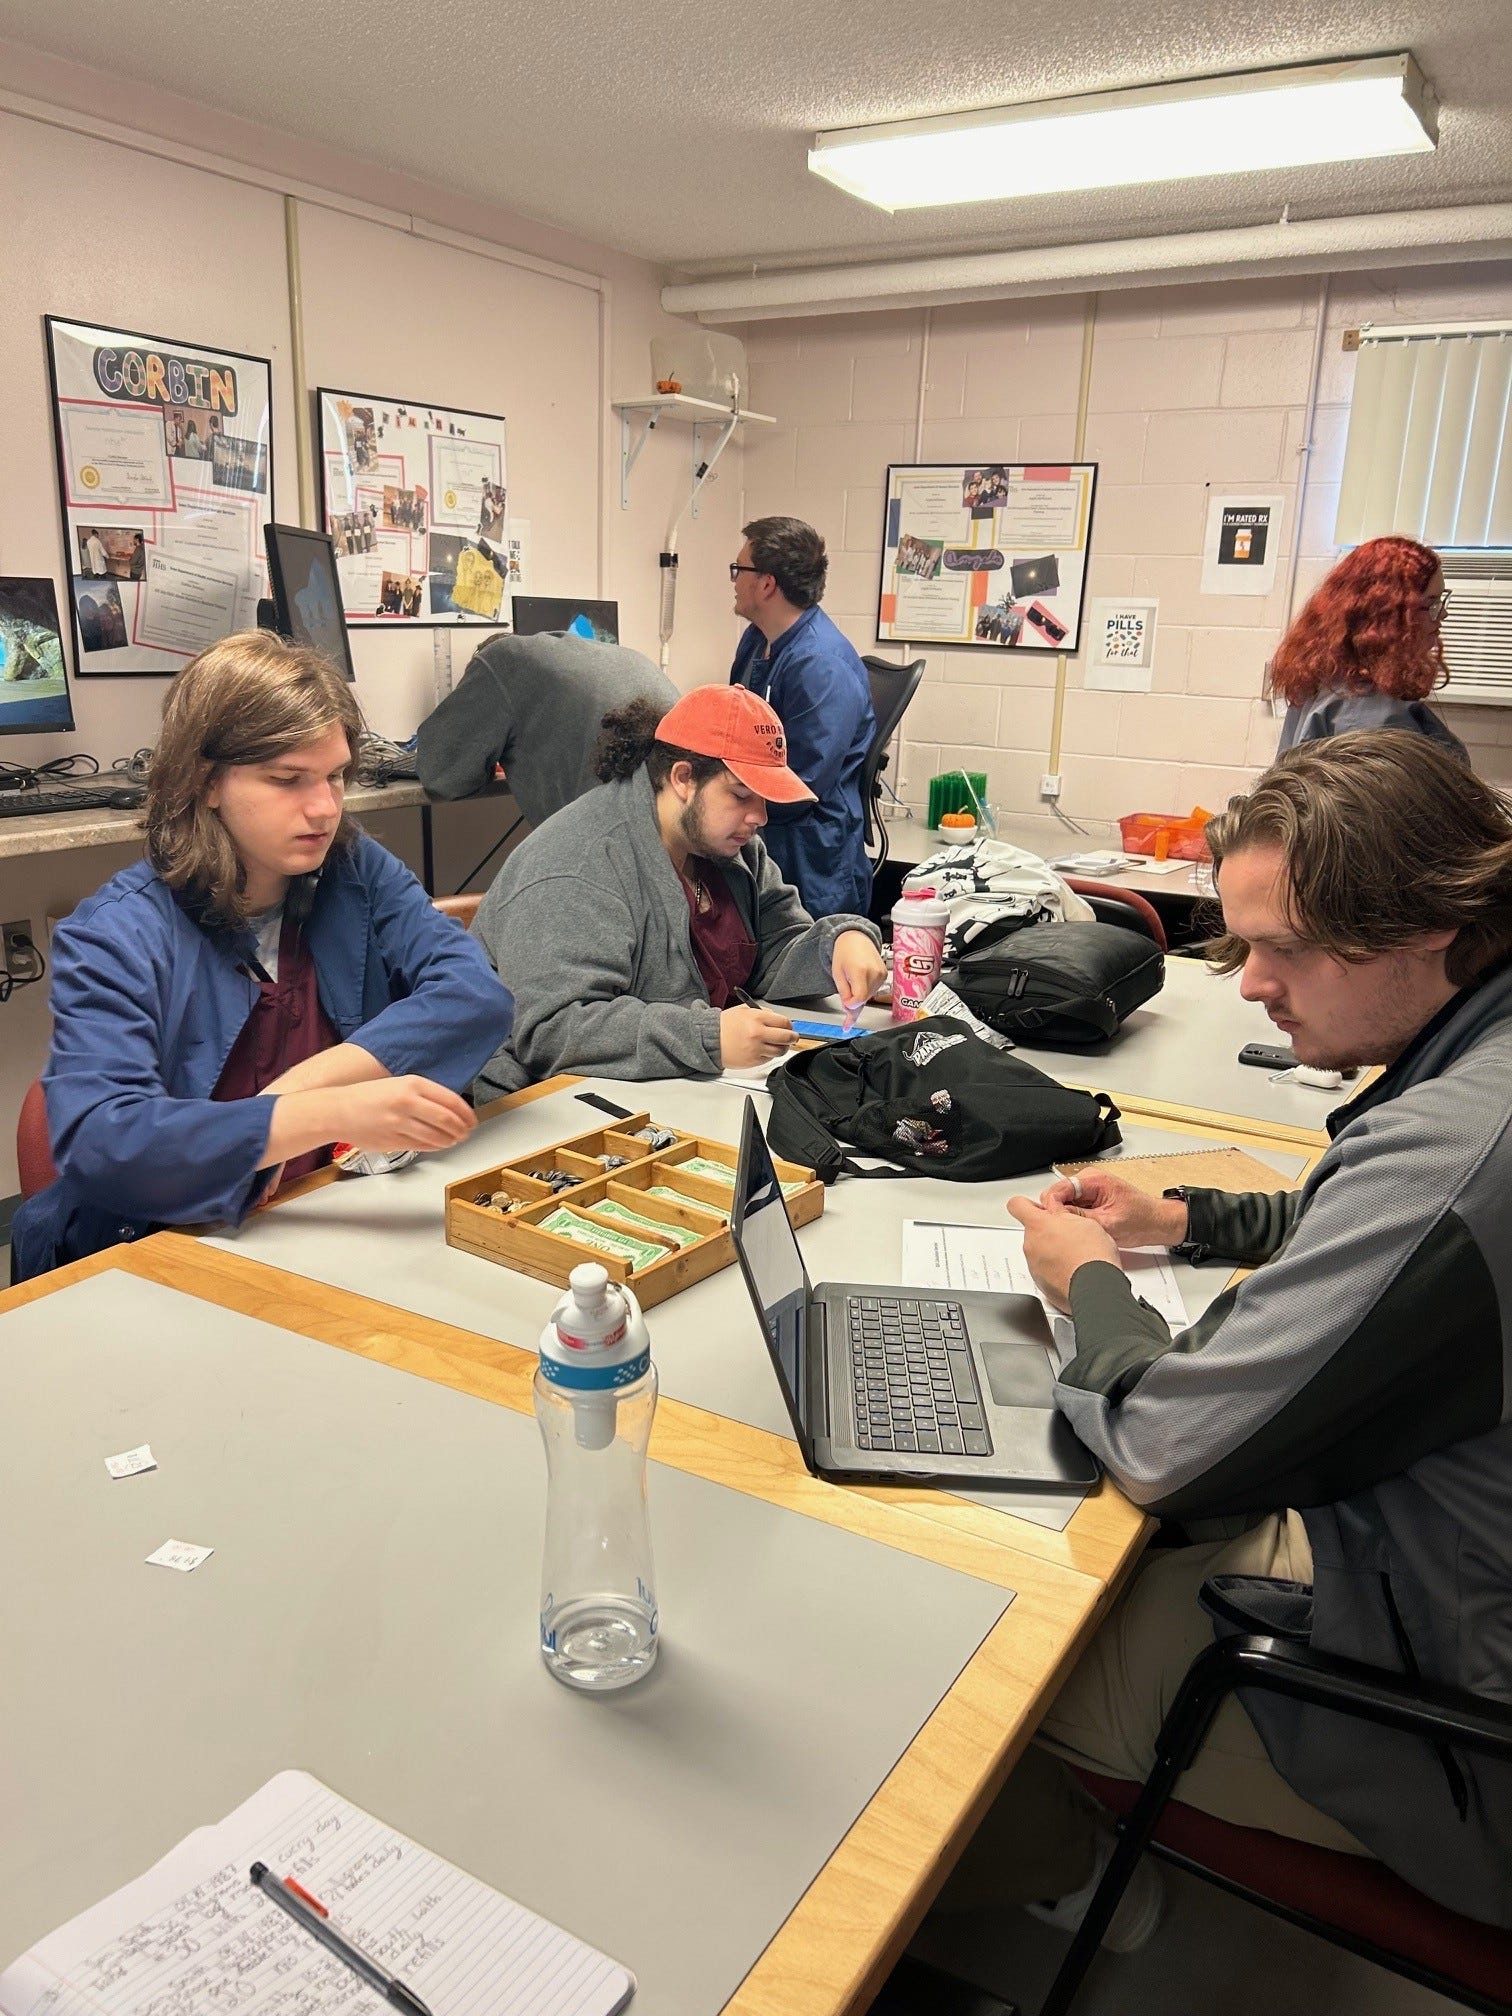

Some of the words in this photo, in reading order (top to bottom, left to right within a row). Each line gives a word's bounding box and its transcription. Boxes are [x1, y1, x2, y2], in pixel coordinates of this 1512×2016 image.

[98, 348, 236, 413] CORBIN
[1223, 514, 1235, 523] I'M
[1236, 514, 1257, 523] RATED
[1258, 514, 1268, 523] RX
[1107, 620, 1143, 630] PILLS
[1106, 648, 1119, 658] for
[1121, 648, 1139, 657] that
[753, 725, 777, 735] VERO
[900, 997, 923, 1008] GAM
